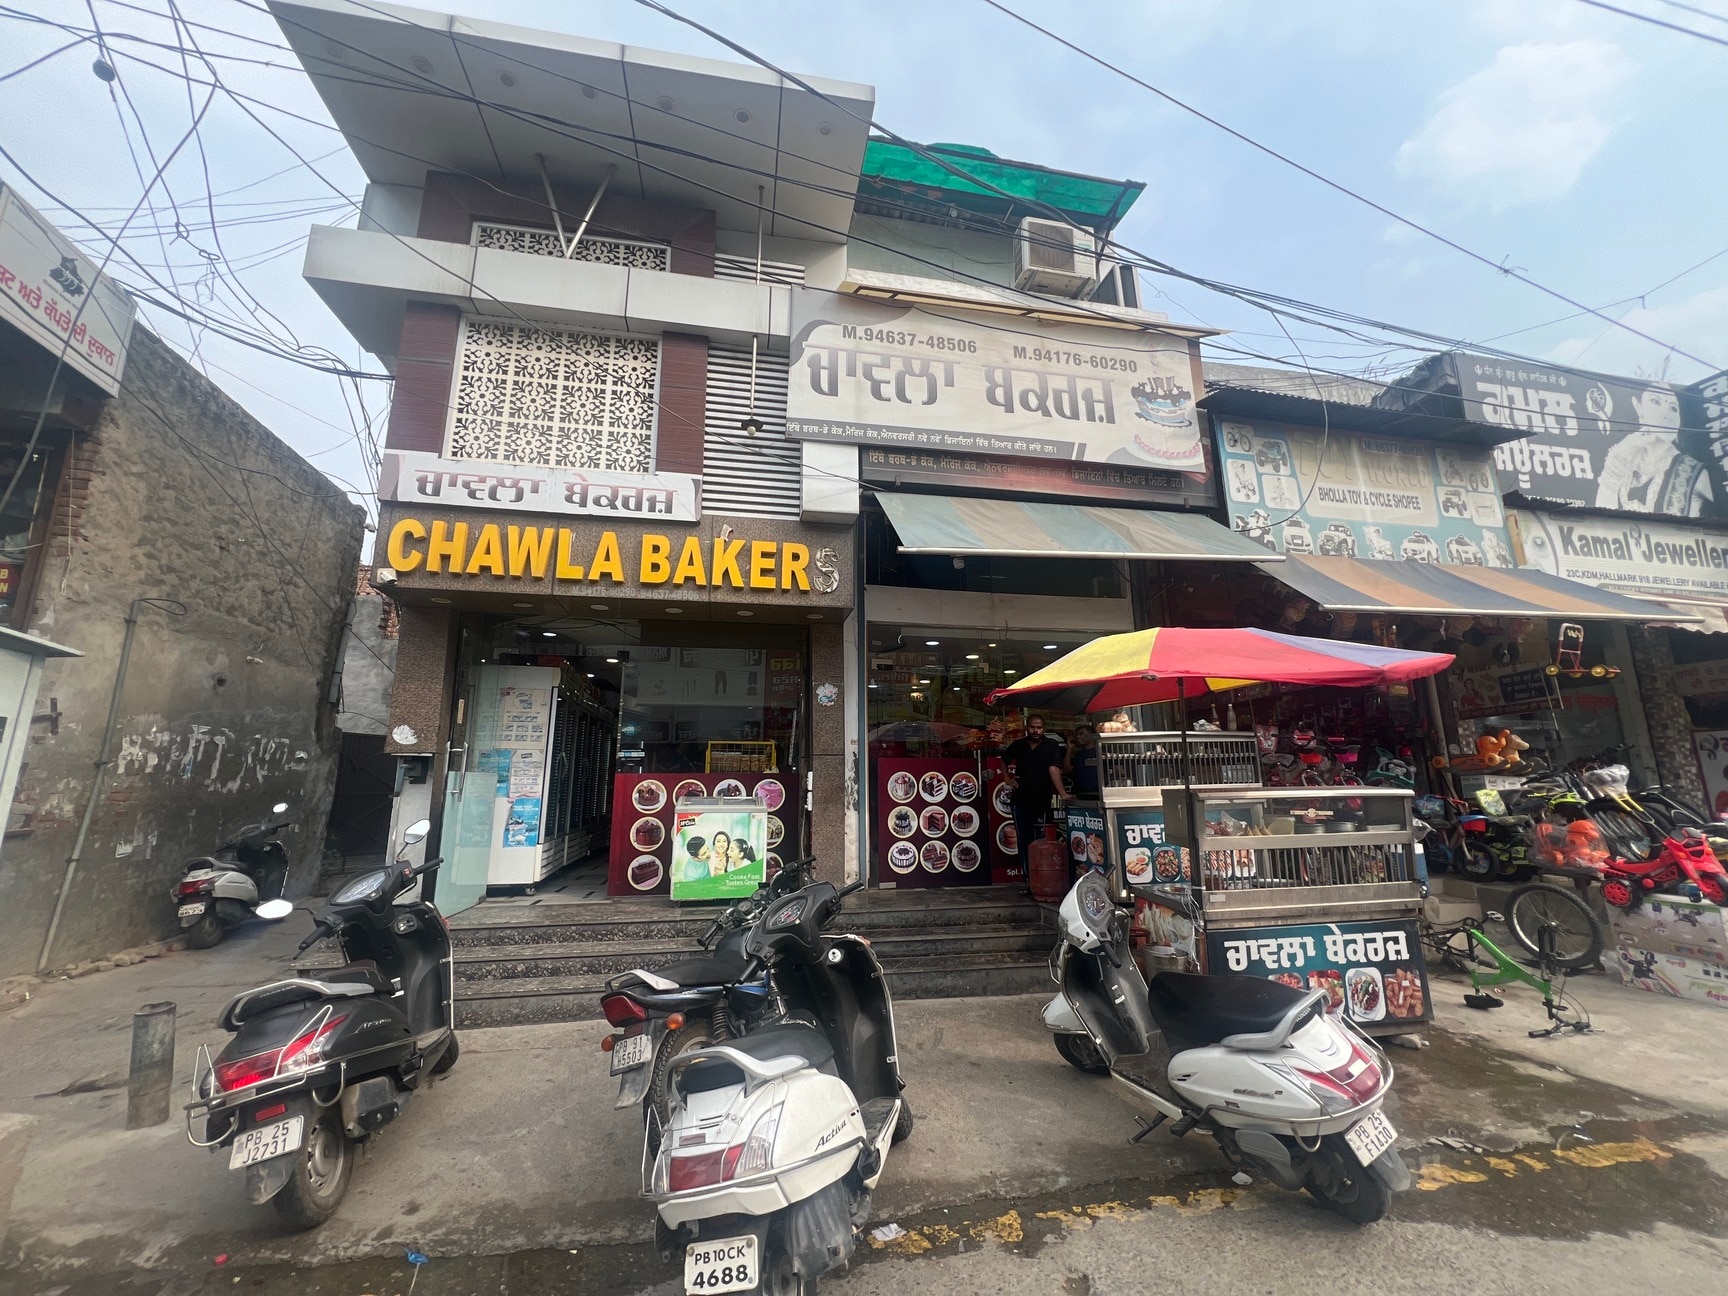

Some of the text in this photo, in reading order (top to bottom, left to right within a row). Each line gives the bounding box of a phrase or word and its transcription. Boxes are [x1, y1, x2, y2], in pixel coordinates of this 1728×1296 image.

[19, 280, 43, 310] ਅਤੇ
[73, 322, 88, 345] ਦੀ
[87, 333, 116, 367] ਦੁਕਾਨ
[841, 323, 978, 355] M.94637-48506
[805, 339, 963, 406] ਚਾਵਲਾ
[1012, 344, 1138, 374] M.94176-60290
[1476, 381, 1579, 436] ਕਮਲ
[415, 468, 681, 515] ਚਾਵਲਾ ਬੇਕਰਜ਼
[1318, 487, 1421, 510] BHOLLA TOY & CYCLE SHOPEE
[387, 517, 841, 594] CHAWLA BAKERS
[1558, 525, 1634, 562] Kamal
[1651, 575, 1690, 588] JEWELLERY
[1691, 580, 1726, 591] AVAILABLE
[1124, 823, 1166, 845] ਚਾਵ
[1223, 923, 1411, 972] ਚਾਵਲਾ ਬੇਕਰਜ਼
[633, 1035, 643, 1050] 91
[245, 1121, 289, 1149] PB 25
[814, 1119, 848, 1152] Activa
[1354, 1112, 1383, 1145] PB 25
[1365, 1127, 1393, 1158] F1430
[242, 1137, 287, 1164] J2731
[692, 1264, 749, 1289] 4688
